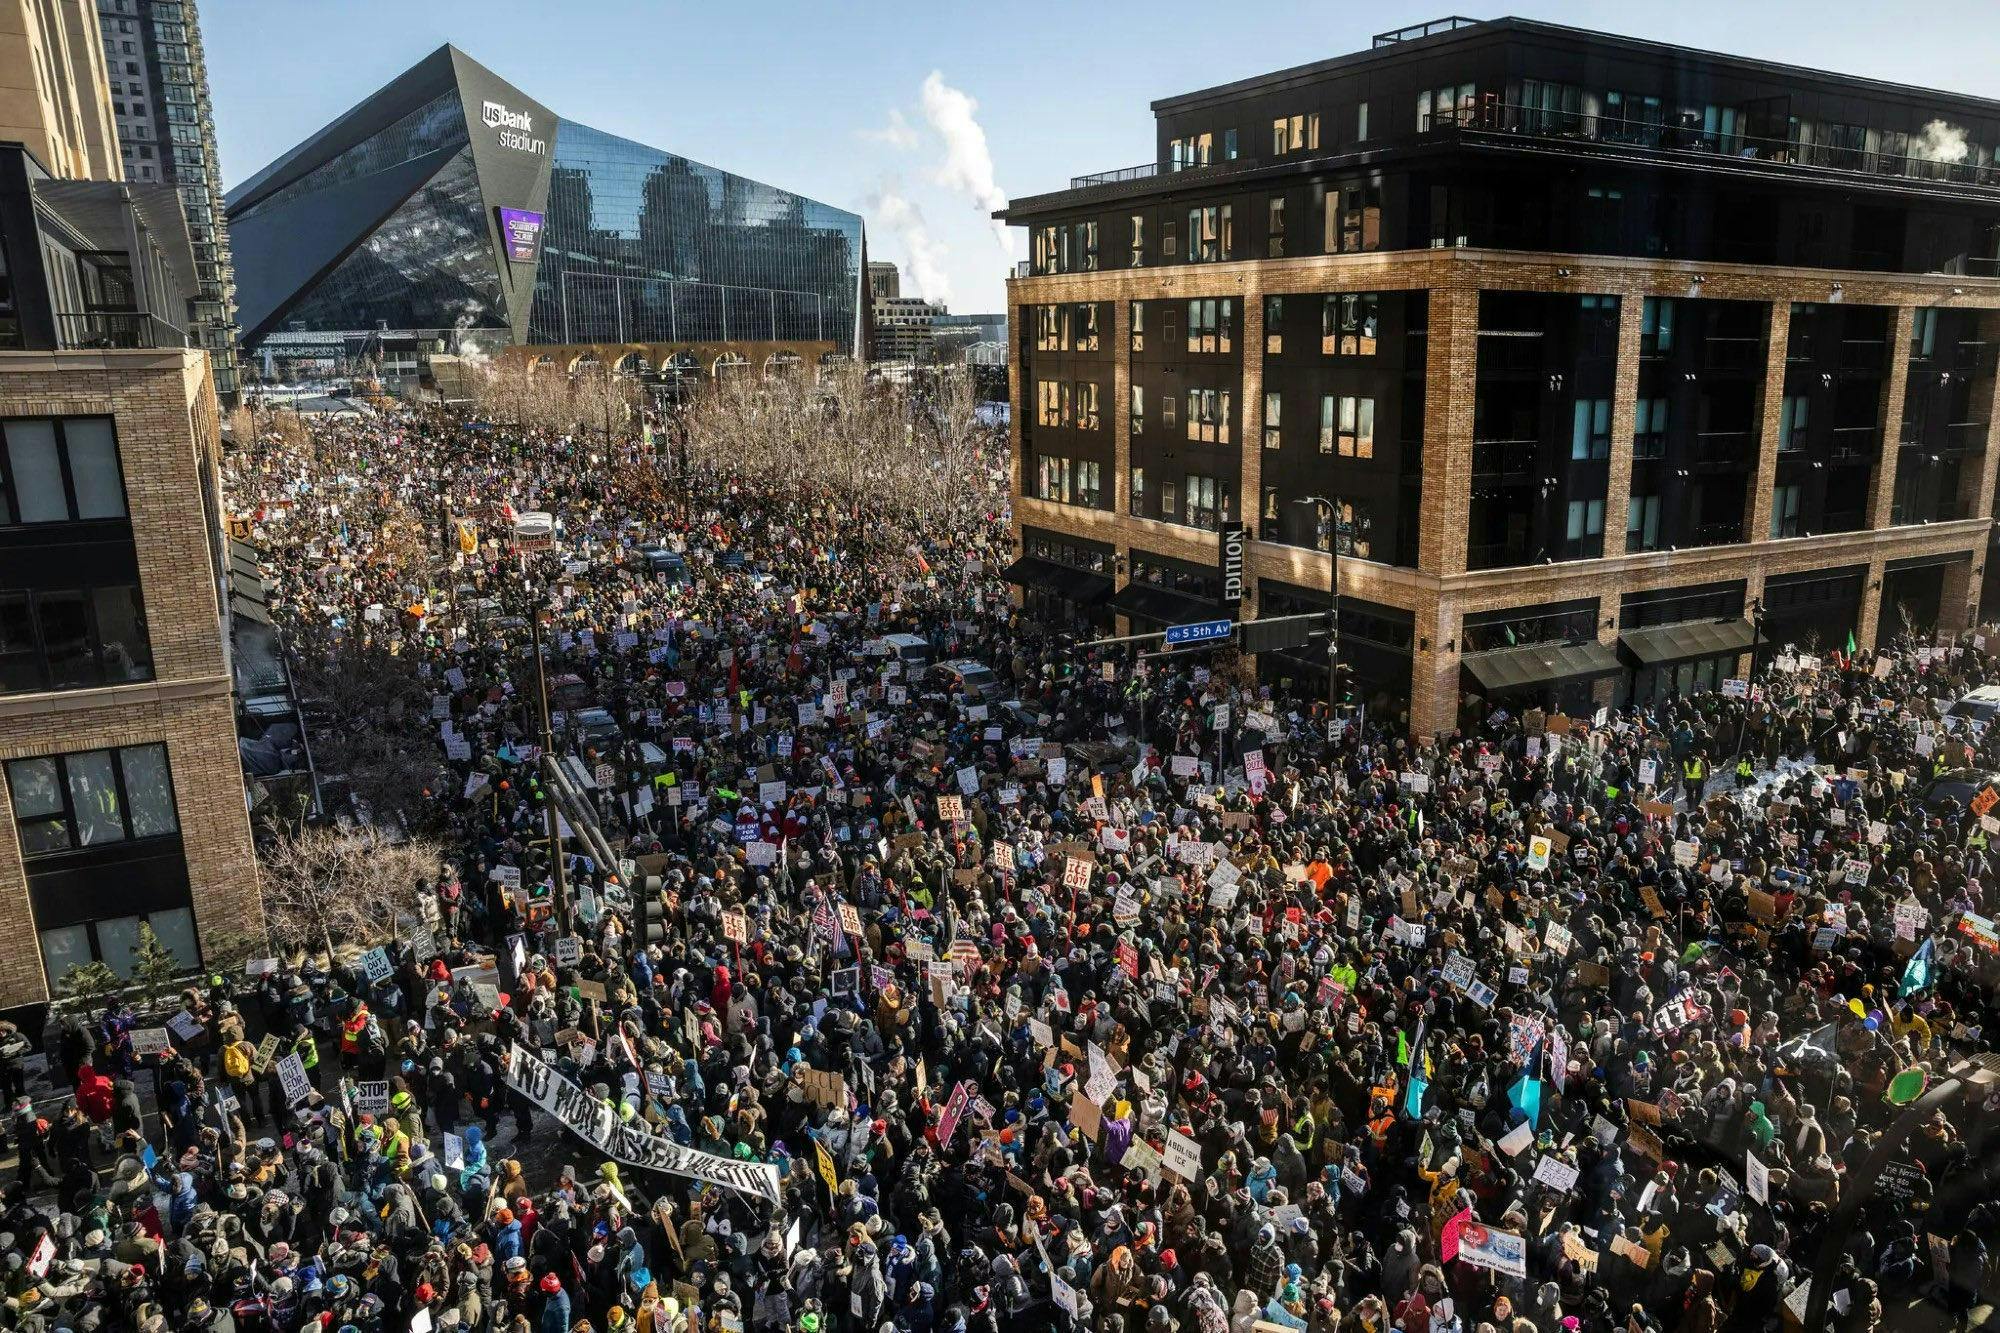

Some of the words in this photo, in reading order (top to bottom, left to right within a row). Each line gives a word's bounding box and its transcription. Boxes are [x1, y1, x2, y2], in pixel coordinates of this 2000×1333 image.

[499, 129, 545, 155] stadium
[1225, 531, 1242, 600] EDITION
[1182, 628, 1189, 638] S
[1193, 625, 1211, 637] 5th
[1215, 624, 1229, 635] Av
[1217, 713, 1227, 721] ONE
[674, 739, 692, 747] GTFO
[1246, 752, 1262, 761] ICE
[598, 769, 613, 778] ICE
[683, 782, 699, 790] STOP
[1189, 784, 1204, 793] ICE
[828, 794, 846, 803] ICE
[941, 802, 959, 810] ICE
[941, 809, 961, 818] OUT!
[1093, 809, 1105, 817] ICE
[995, 845, 1011, 857] ICE
[1182, 840, 1208, 850] BRING
[1067, 862, 1087, 874] ICE
[1066, 873, 1087, 887] OUT!
[725, 913, 744, 927] ICE
[841, 908, 858, 921] ICE
[558, 939, 576, 948] ONE
[364, 951, 380, 962] ICE
[559, 947, 575, 956] WAY
[367, 957, 383, 970] OUT
[370, 963, 388, 979] NOW
[279, 1055, 297, 1070] ICE
[281, 1065, 300, 1082] OUT
[286, 1075, 303, 1092] FOR
[360, 1082, 387, 1097] STOP
[288, 1083, 311, 1102] GOOD
[517, 1050, 551, 1101] NO
[554, 1078, 608, 1144] MORE
[1168, 1138, 1198, 1162] ABOLISH
[1174, 1155, 1187, 1168] ICE
[1465, 1226, 1479, 1238] Pro
[1459, 1252, 1476, 1262] Hands
